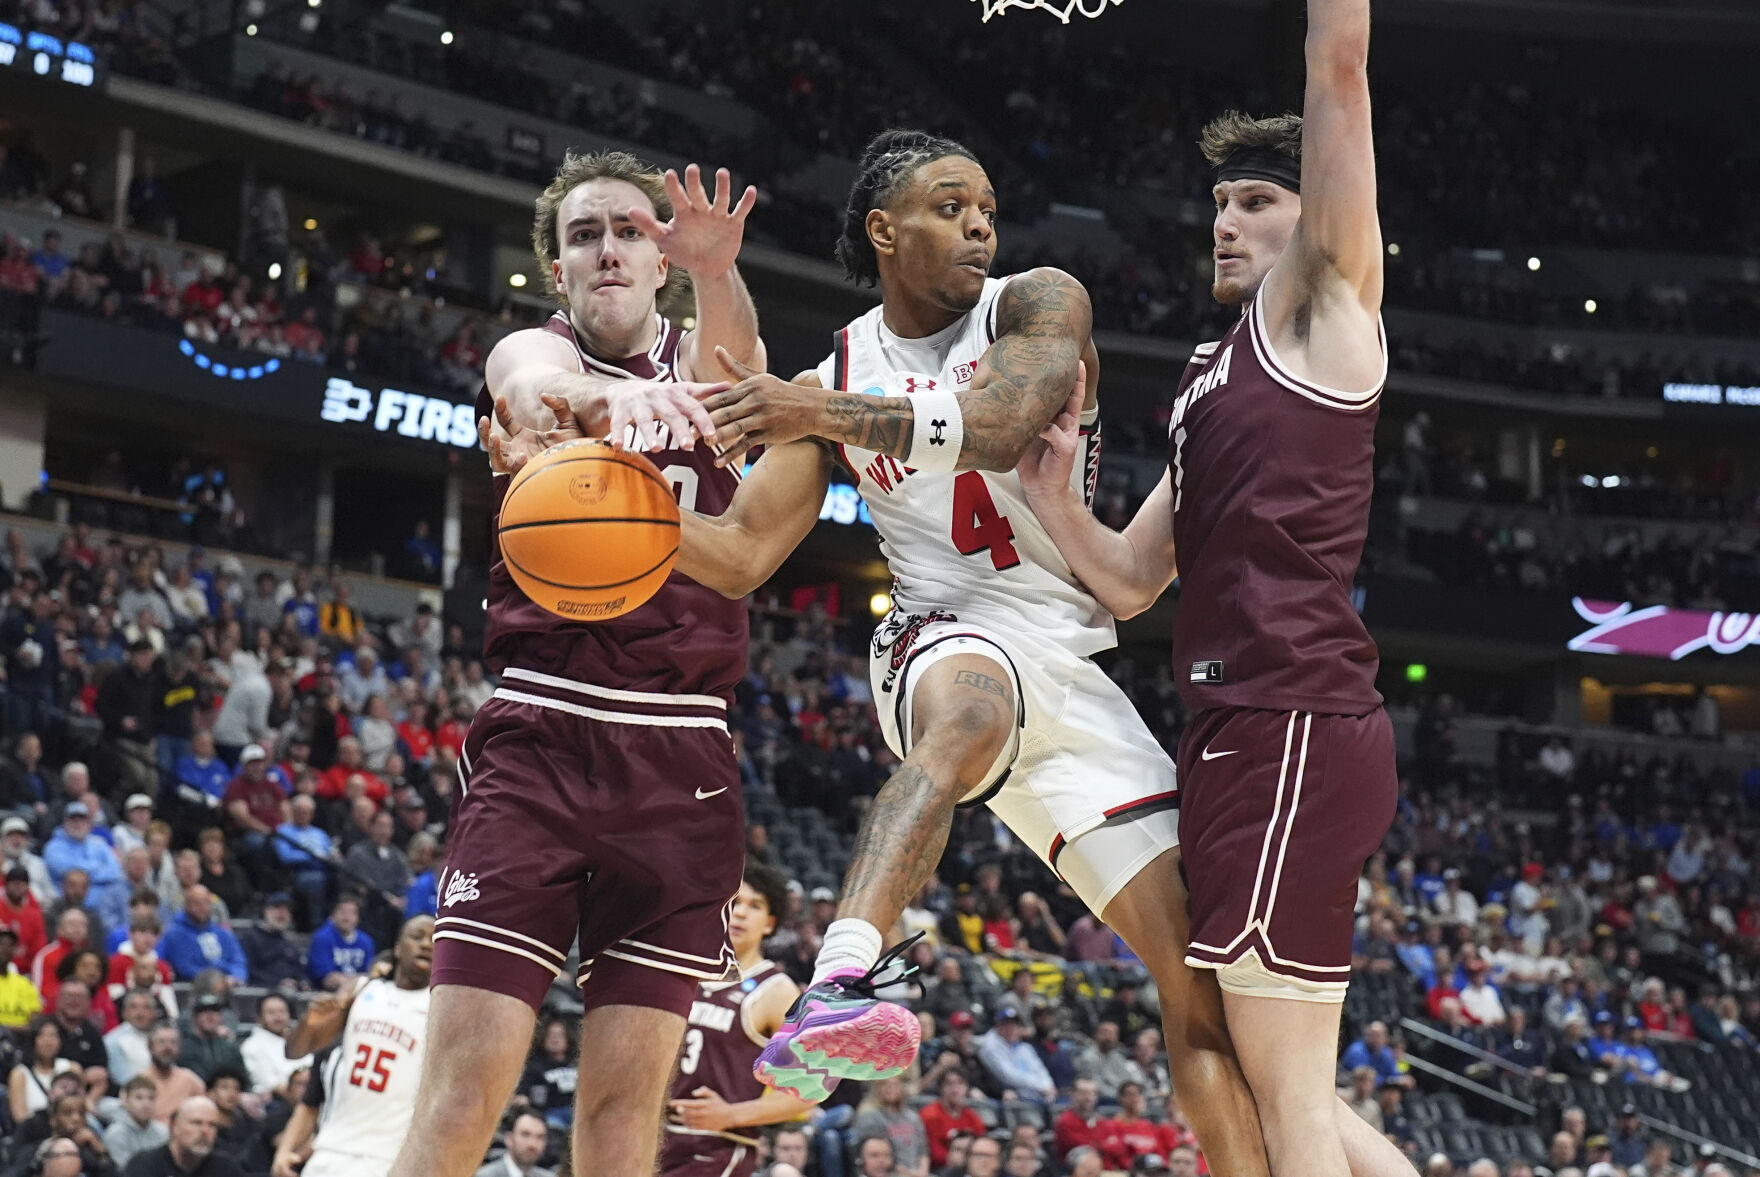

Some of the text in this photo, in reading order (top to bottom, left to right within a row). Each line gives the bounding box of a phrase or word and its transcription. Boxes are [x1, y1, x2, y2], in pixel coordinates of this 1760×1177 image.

[374, 387, 489, 452] FIRS
[951, 470, 1021, 572] 4
[443, 869, 480, 908] Griz
[349, 1043, 397, 1094] 25
[680, 1028, 704, 1075] 3
